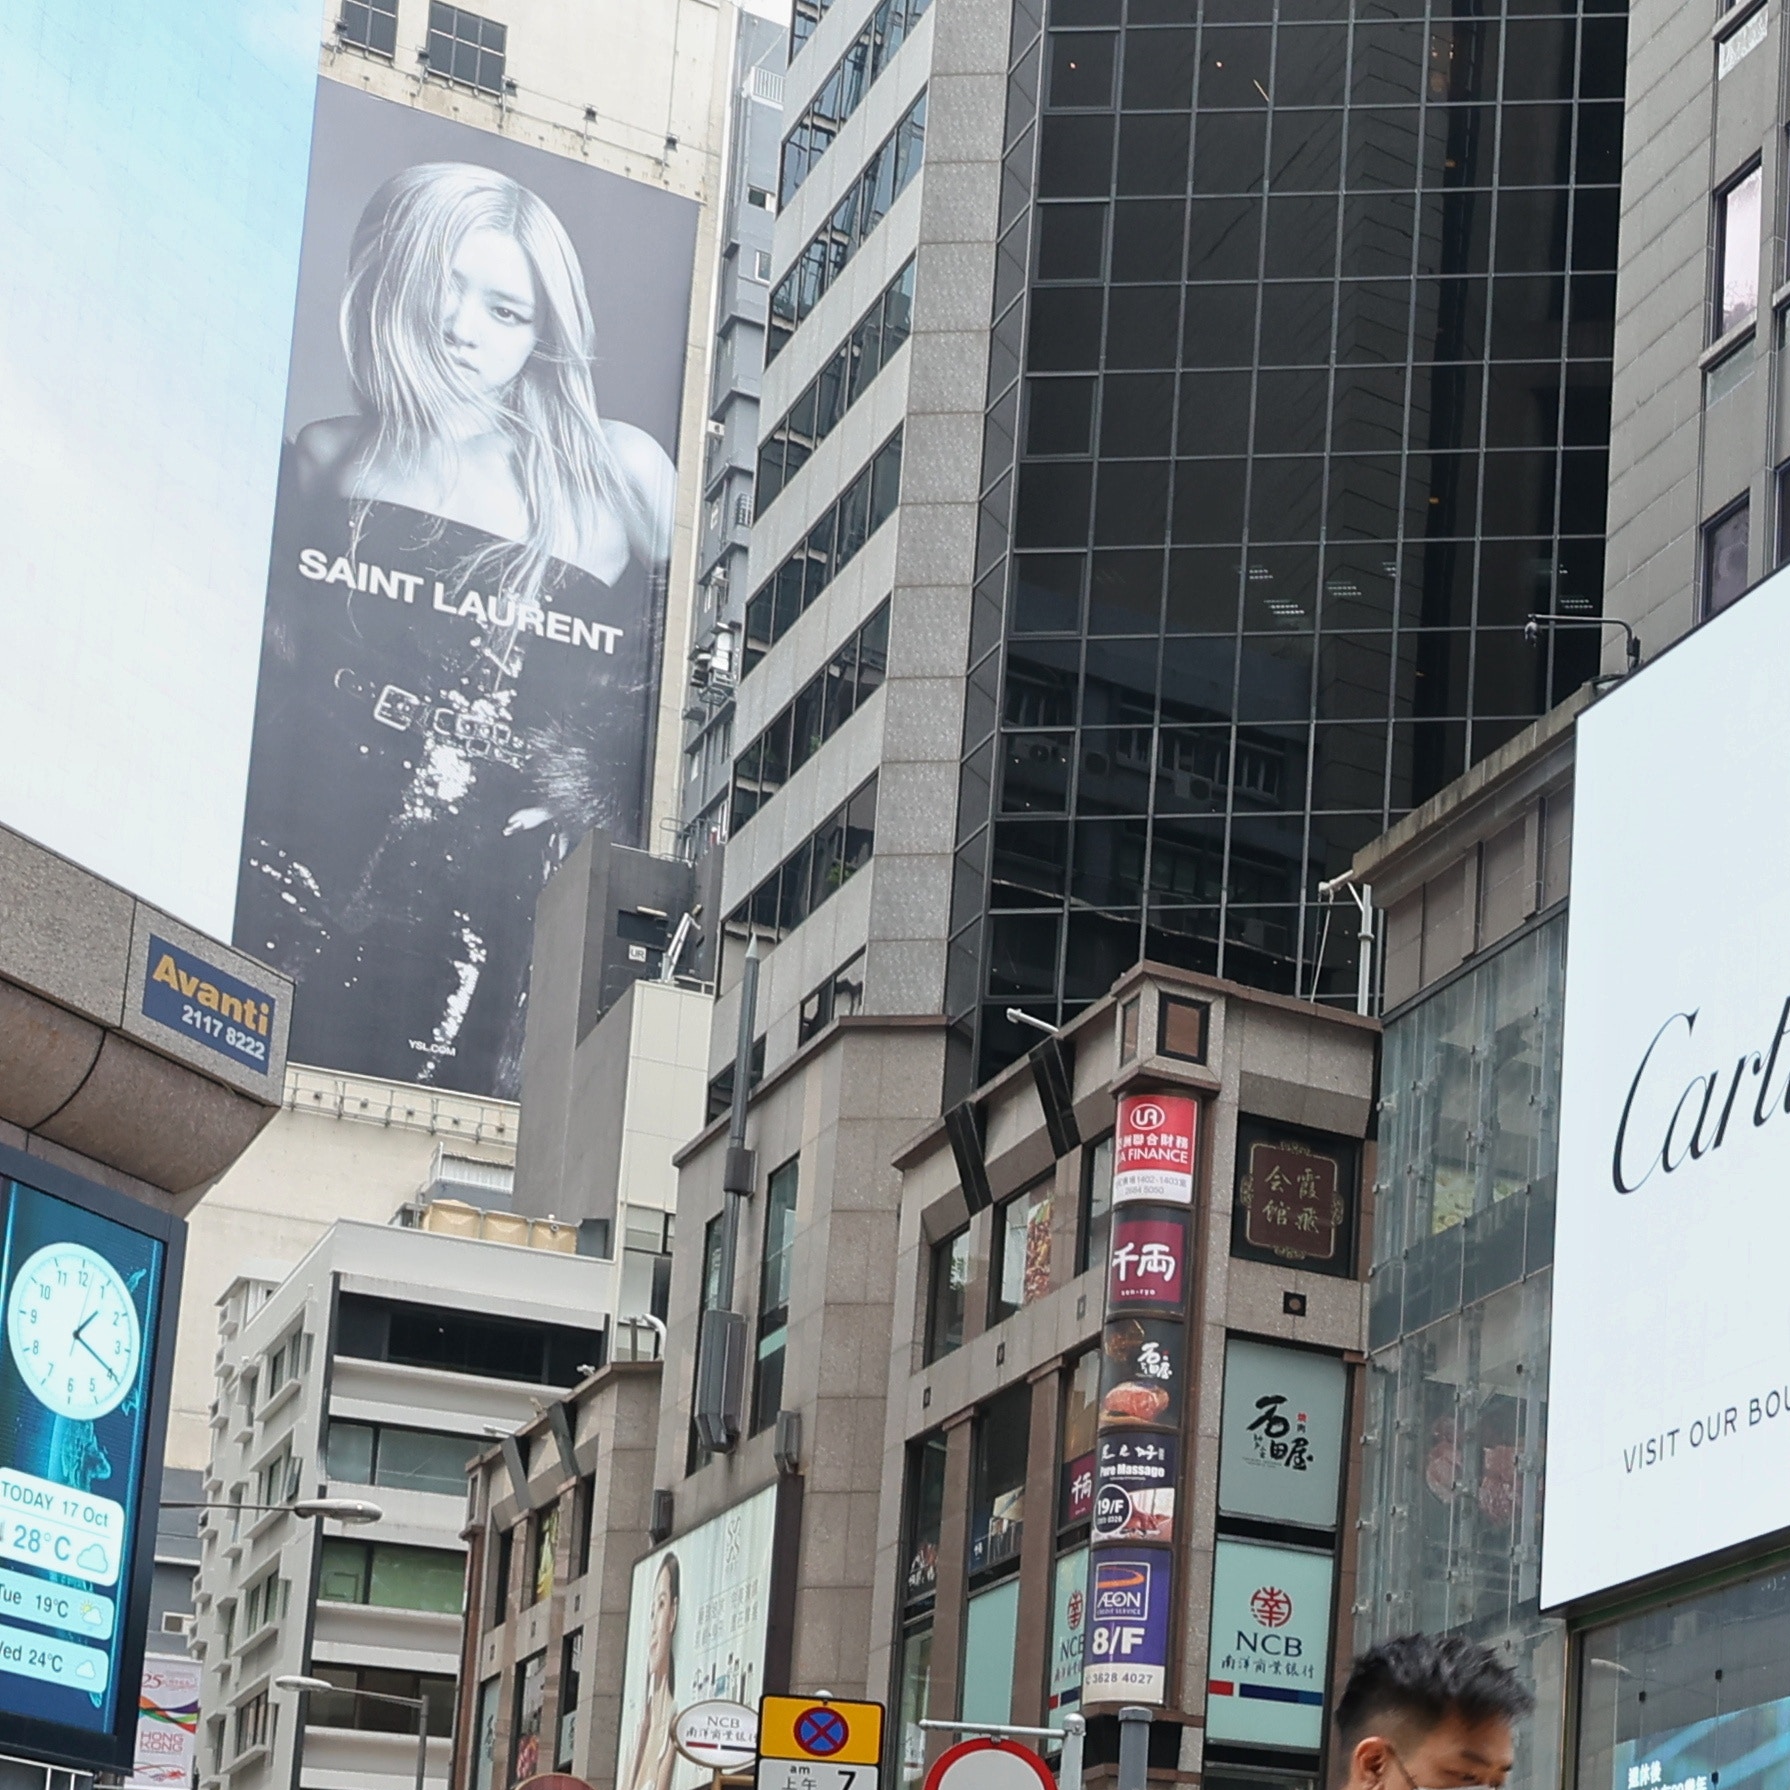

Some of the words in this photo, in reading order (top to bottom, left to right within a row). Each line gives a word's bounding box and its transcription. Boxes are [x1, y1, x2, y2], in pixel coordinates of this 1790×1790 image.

[299, 548, 423, 605] SAINT
[432, 580, 624, 655] LAURENT
[153, 954, 269, 1036] Avanti
[182, 1005, 223, 1038] 2117
[226, 1027, 265, 1060] 8222
[408, 1039, 456, 1057] YSL.COM
[1128, 1147, 1188, 1164] FINANCE
[57, 1271, 68, 1286] 11
[78, 1271, 88, 1287] 12
[40, 1284, 51, 1300] 10
[1623, 1430, 1680, 1474] VISIT
[1689, 1407, 1738, 1448] OUR
[1117, 1463, 1165, 1478] Massage
[1, 1481, 53, 1511] TODAY
[62, 1501, 78, 1518] 17
[83, 1506, 109, 1527] Oct
[1092, 1628, 1145, 1655] 8/F
[1236, 1631, 1302, 1657] NCB
[1221, 1654, 1315, 1679] 南洋商業銀行
[1122, 1673, 1153, 1684] 4027
[707, 1715, 740, 1729] NCB
[140, 1731, 184, 1743] HONG
[139, 1741, 184, 1752] KONG
[790, 1765, 810, 1774] am
